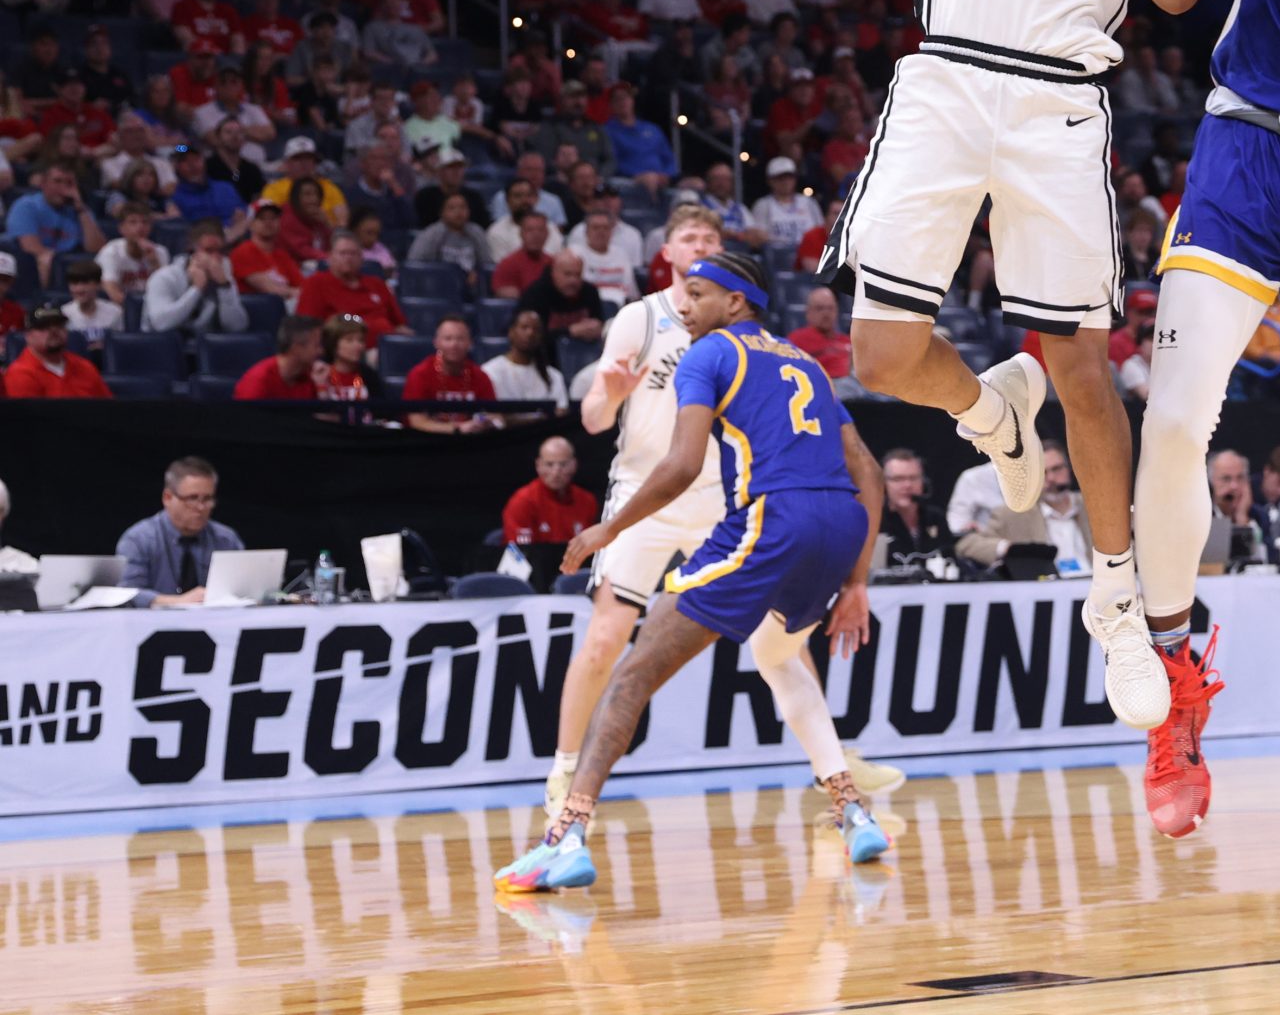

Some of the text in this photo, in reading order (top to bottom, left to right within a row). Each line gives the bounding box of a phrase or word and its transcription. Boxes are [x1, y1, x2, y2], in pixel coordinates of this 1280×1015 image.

[780, 364, 822, 437] 2
[127, 612, 652, 785] SECON
[704, 596, 1210, 750] ROUN
